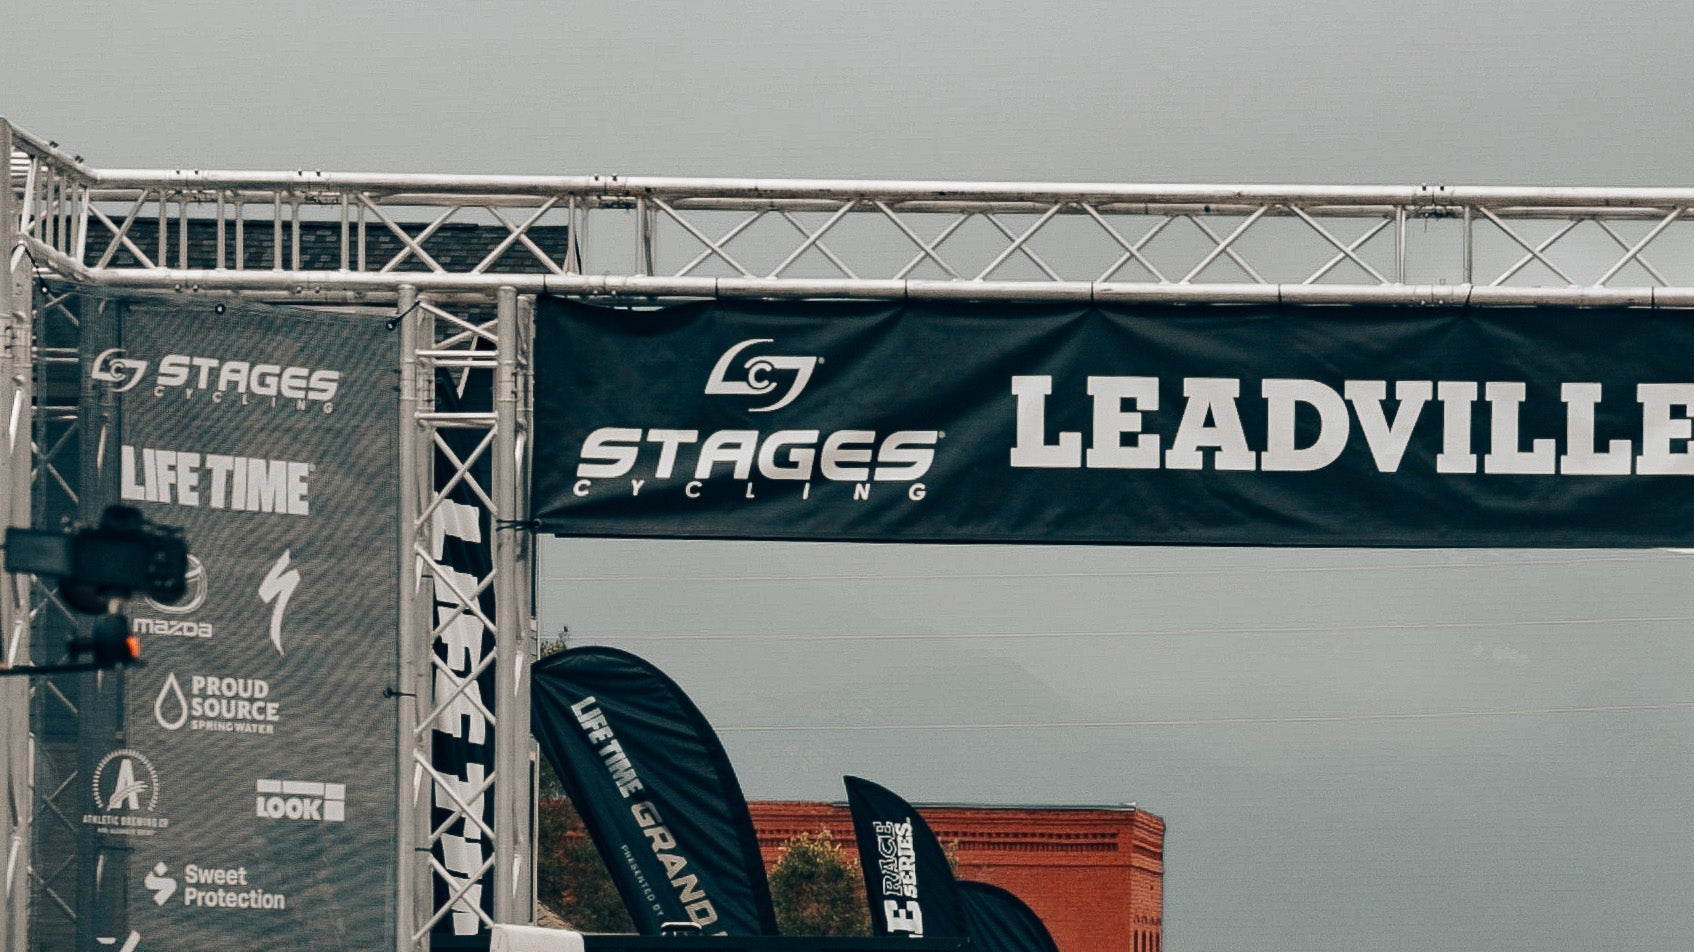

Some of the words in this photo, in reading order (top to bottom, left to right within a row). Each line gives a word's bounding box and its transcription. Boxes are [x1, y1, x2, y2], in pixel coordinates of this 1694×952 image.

[156, 354, 341, 401] STAGES
[153, 386, 334, 414] CYCLING
[577, 427, 934, 481] STAGES
[572, 481, 927, 500] CYCLING
[132, 618, 213, 638] mazda
[191, 675, 270, 699] PROUD
[190, 697, 280, 722] SOURCE
[190, 720, 233, 732] SPRING
[235, 723, 275, 735] WATER
[256, 797, 323, 821] LOOK
[630, 801, 719, 927] GRAND
[872, 820, 903, 897] RACE
[895, 817, 919, 899] SERIES
[184, 864, 248, 886] Sweet
[184, 886, 287, 910] Protection
